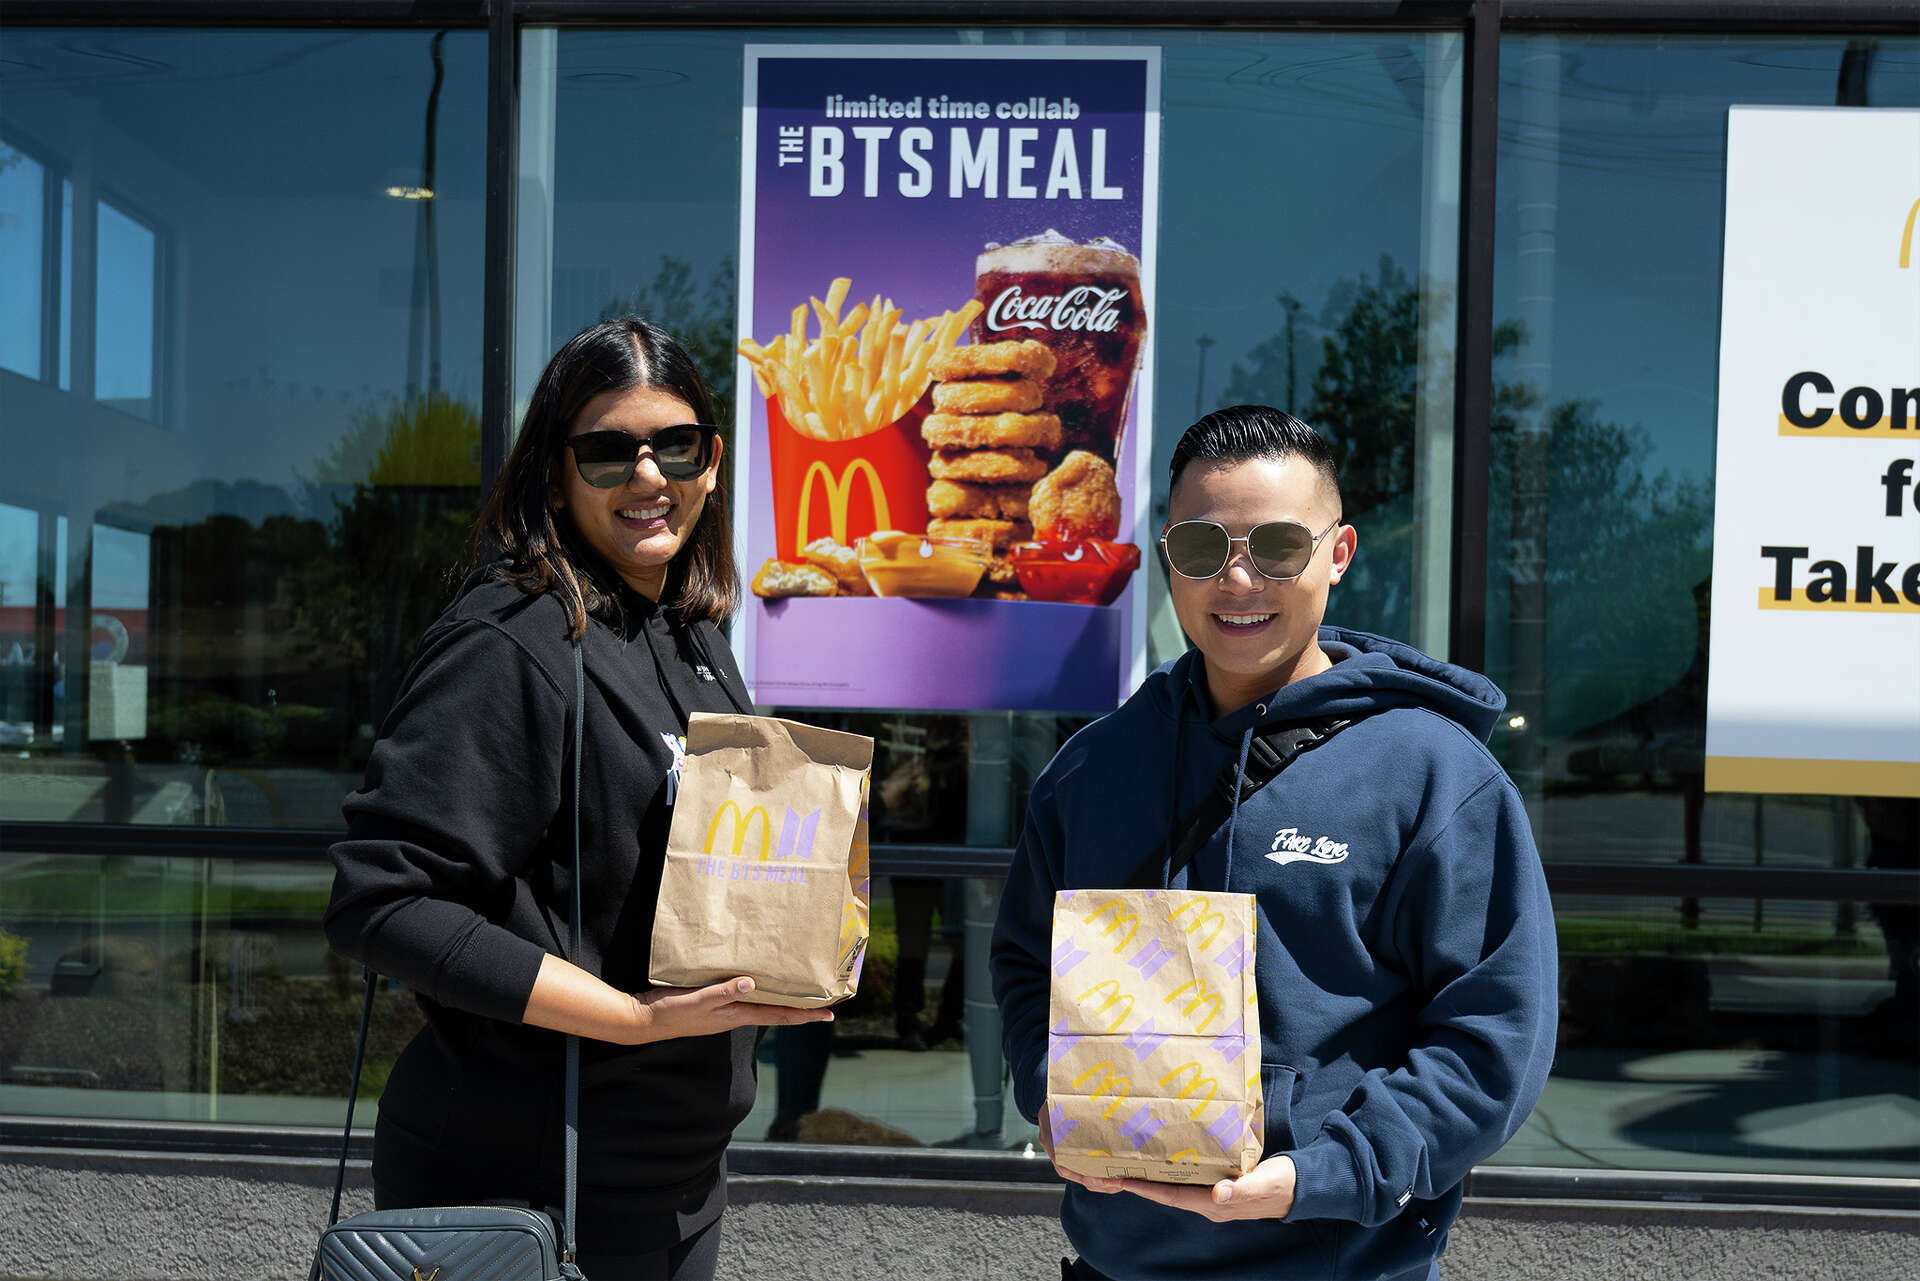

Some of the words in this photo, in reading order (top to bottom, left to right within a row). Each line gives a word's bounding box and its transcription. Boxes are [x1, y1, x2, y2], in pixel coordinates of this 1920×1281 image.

[825, 94, 922, 118] limited
[927, 95, 990, 119] time
[996, 97, 1080, 120] collab
[778, 126, 804, 167] THE
[809, 126, 934, 198] BTS
[949, 127, 1123, 200] MEAL
[986, 285, 1128, 332] Coca-Cola
[696, 857, 727, 878] THE
[729, 862, 763, 880] BTS
[765, 865, 808, 883] MEAL
